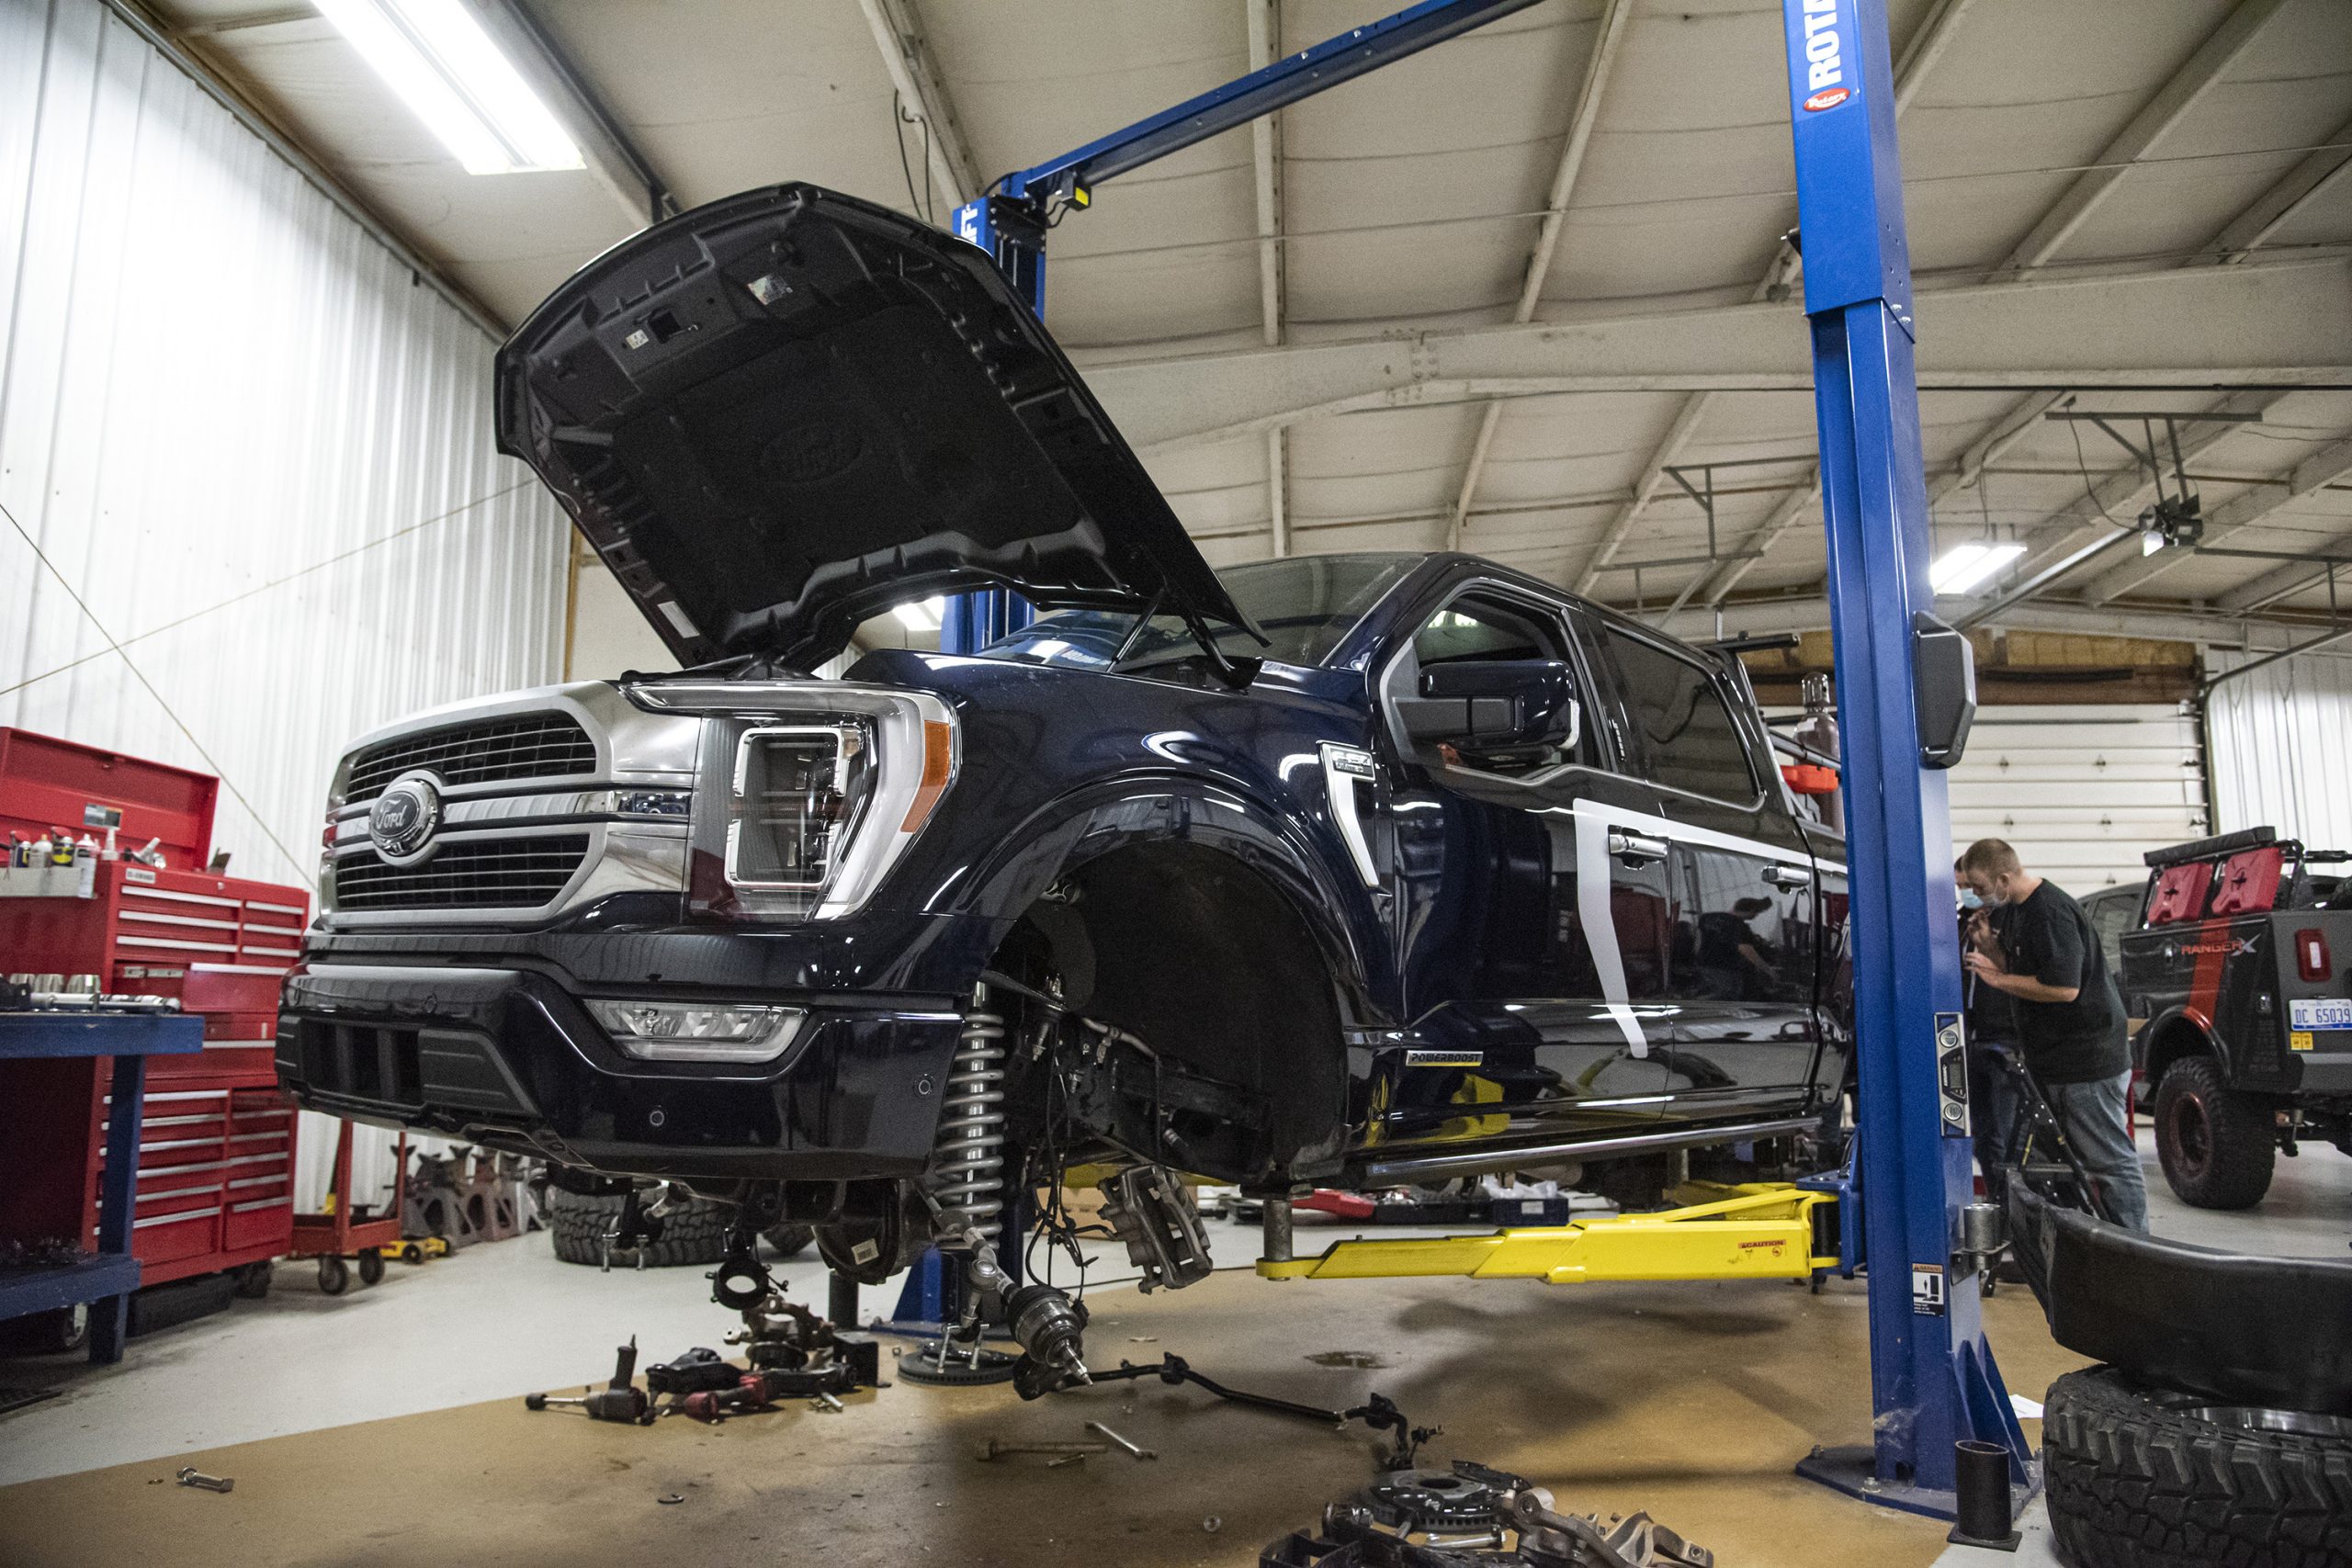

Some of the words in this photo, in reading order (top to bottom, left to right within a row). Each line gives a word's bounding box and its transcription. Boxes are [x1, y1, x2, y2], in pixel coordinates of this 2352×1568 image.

[961, 208, 978, 244] FT
[376, 798, 408, 829] Ford
[2315, 1008, 2351, 1023] 65039
[1411, 1053, 1479, 1062] POWERBOOST
[1747, 1240, 1784, 1248] CAUTION
